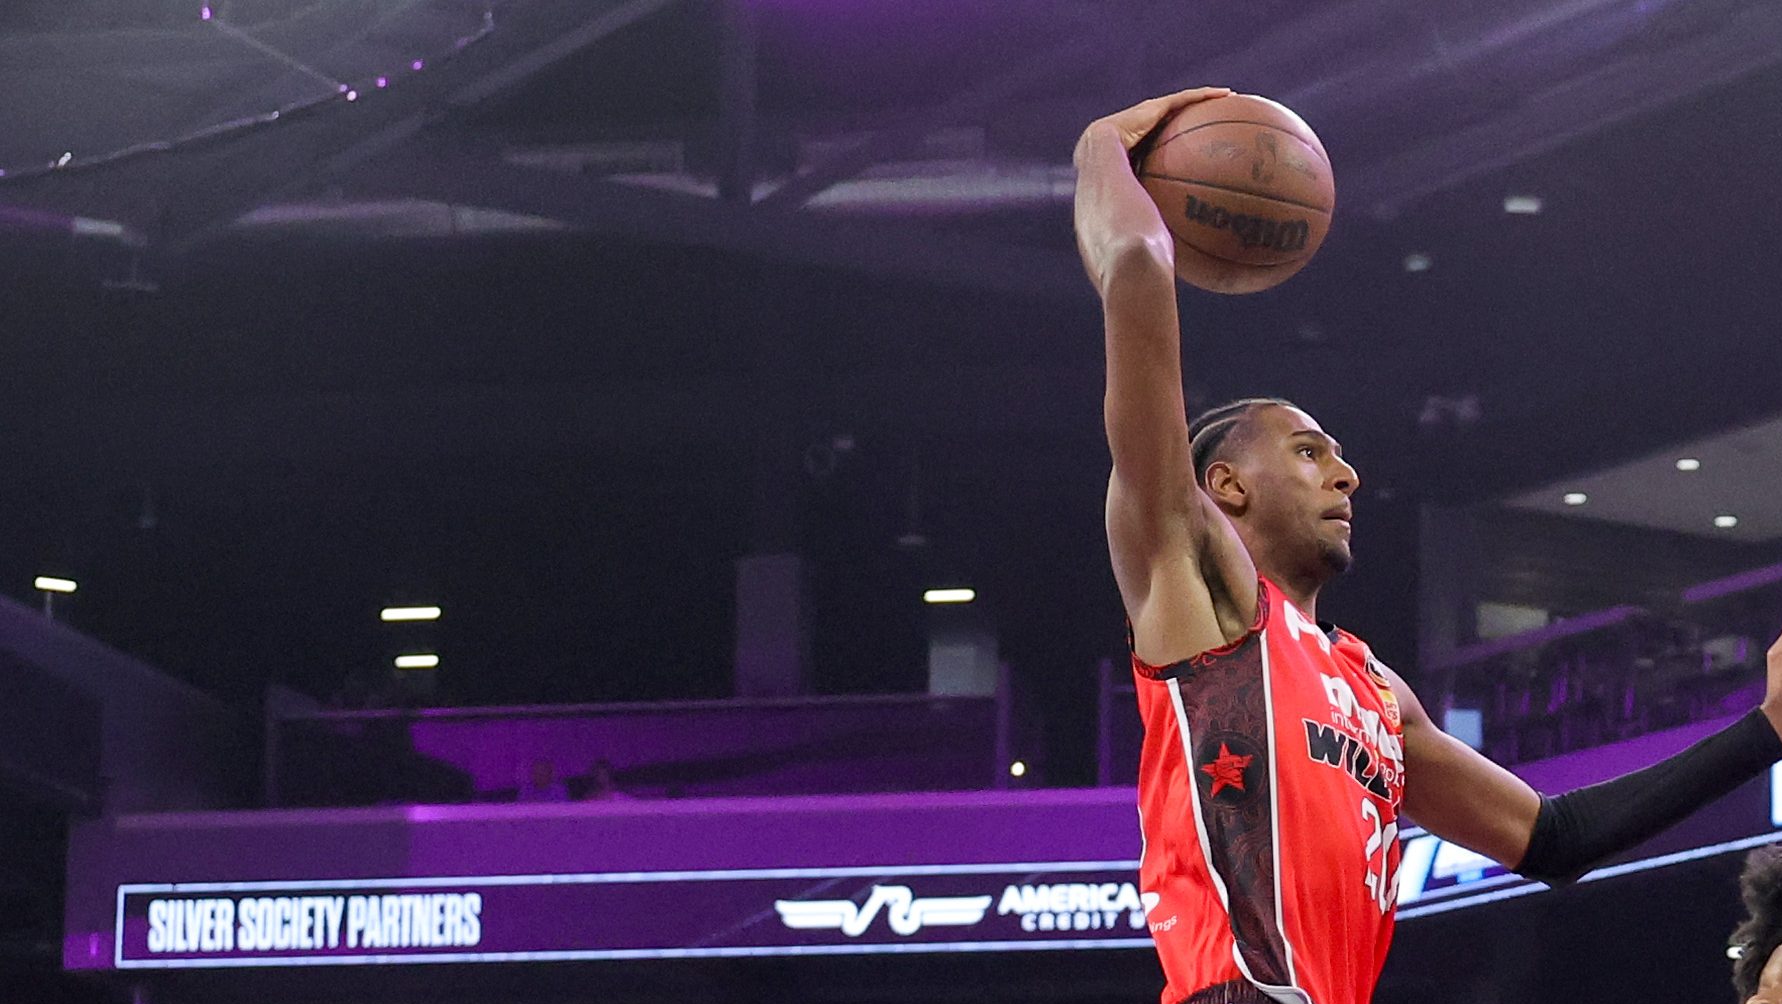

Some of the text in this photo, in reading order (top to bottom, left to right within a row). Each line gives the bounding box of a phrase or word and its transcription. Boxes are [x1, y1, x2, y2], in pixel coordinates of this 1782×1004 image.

[146, 892, 483, 953] SILVER SOCIETY PARTNERS
[1019, 910, 1118, 932] CREDIT
